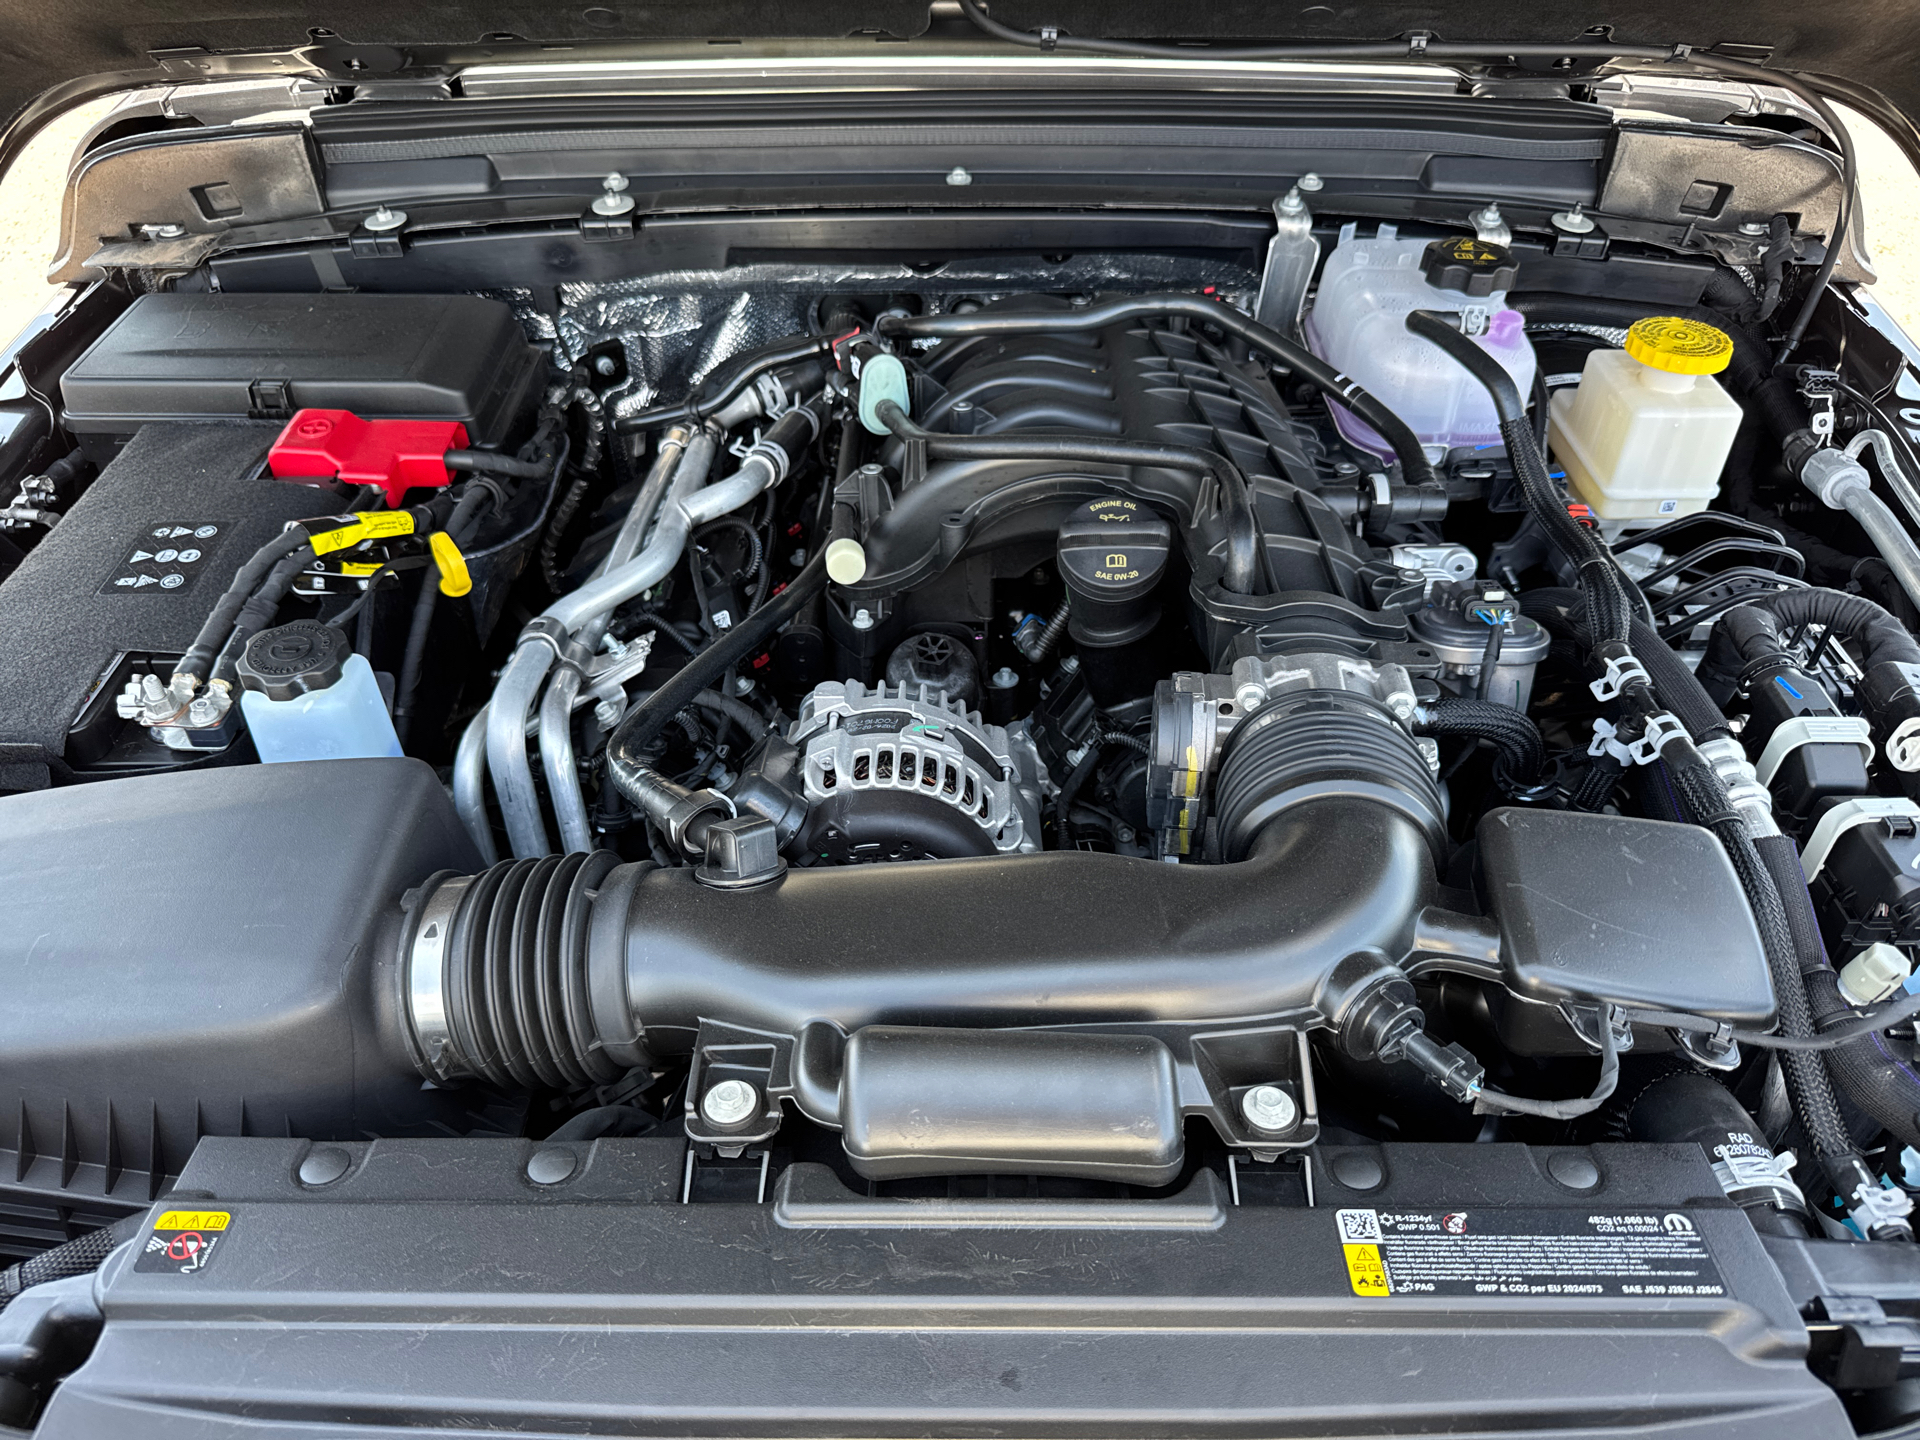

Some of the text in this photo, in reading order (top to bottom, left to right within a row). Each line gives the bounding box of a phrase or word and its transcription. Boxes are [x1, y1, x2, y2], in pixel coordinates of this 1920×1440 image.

[1089, 500, 1137, 512] ENGINE OIL
[1095, 570, 1139, 581] SAE 0W-20
[1727, 1132, 1753, 1144] RAD
[1713, 1143, 1774, 1160] 6280782AD
[1588, 1215, 1612, 1225] 482g
[1613, 1215, 1642, 1225] (1.060
[1414, 1282, 1435, 1291] PAG
[1475, 1283, 1603, 1294] GWP & CO2 per EU 2024/573
[1621, 1285, 1723, 1295] SAE J639 J2842 J2845
